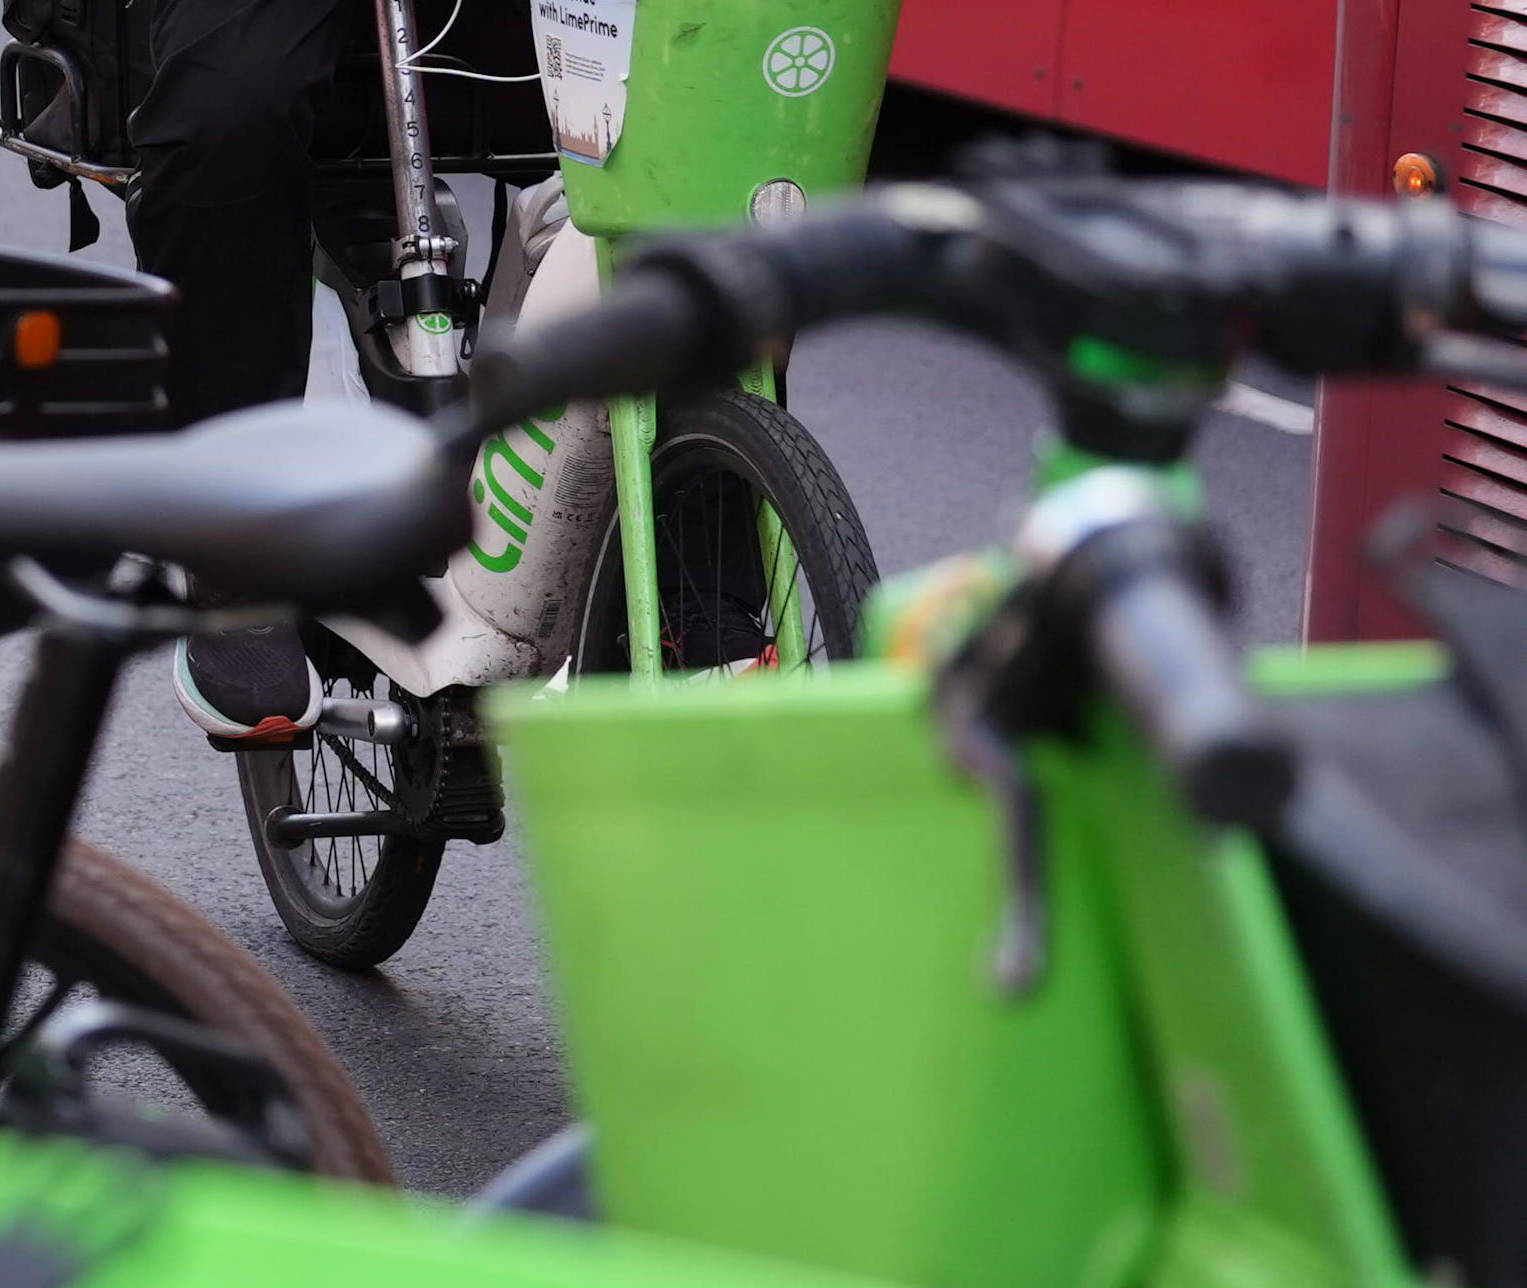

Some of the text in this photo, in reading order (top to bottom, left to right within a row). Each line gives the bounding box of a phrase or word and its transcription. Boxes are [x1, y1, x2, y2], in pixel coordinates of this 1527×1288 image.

[539, 0, 618, 38] with LimePrime
[397, 27, 408, 44] 2
[404, 90, 415, 105] 4
[407, 121, 419, 137] 5
[411, 153, 423, 169] 6
[414, 184, 425, 200] 7
[418, 215, 430, 232] 8
